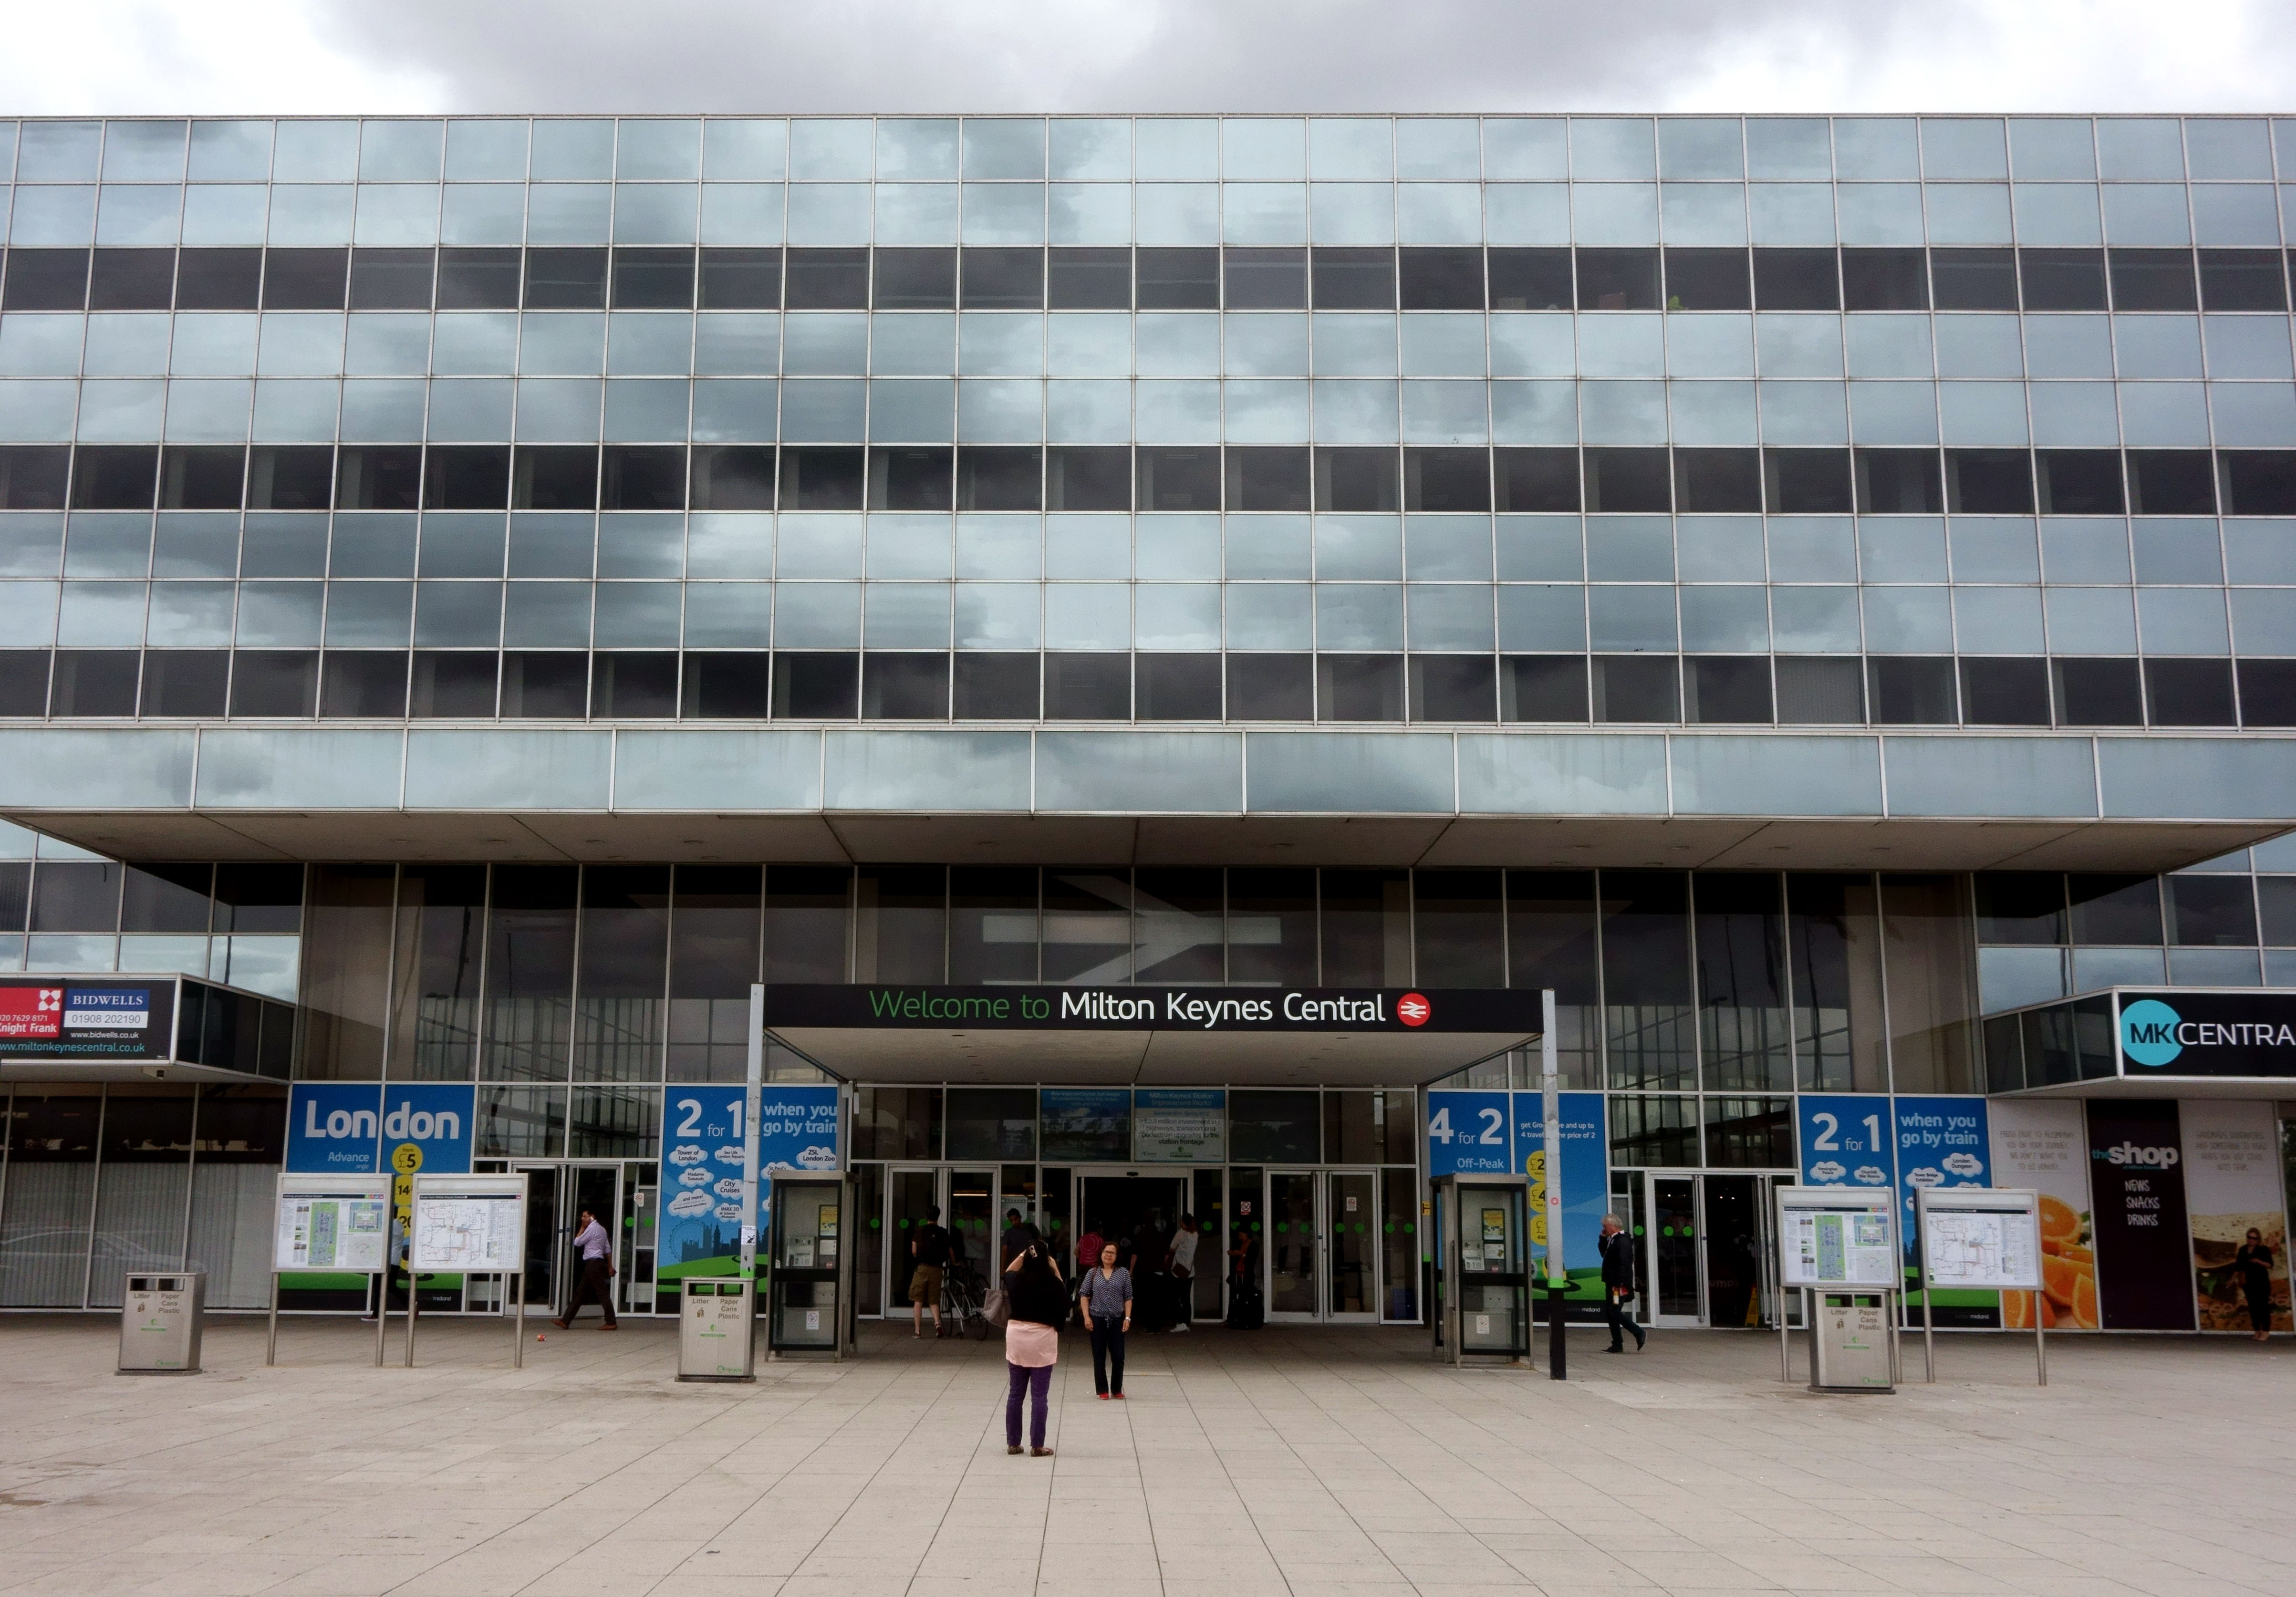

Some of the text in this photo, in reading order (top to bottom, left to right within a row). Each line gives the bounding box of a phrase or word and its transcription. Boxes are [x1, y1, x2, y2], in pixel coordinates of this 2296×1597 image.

[73, 996, 143, 1005] BIDWELLS
[870, 990, 1386, 1028] Welcome to Milton Keynes Central
[72, 1015, 141, 1024] 01908 202190
[30, 1024, 57, 1033] Frank
[676, 1099, 742, 1138] 2 for 1
[764, 1102, 837, 1120] when you
[305, 1100, 460, 1140] London
[763, 1120, 837, 1137] go by train
[1429, 1108, 1503, 1144] 4 for 2
[1900, 1113, 1976, 1130] when you
[1812, 1113, 1880, 1151] 2 for 1
[1901, 1130, 1978, 1148] go by train
[328, 1151, 369, 1162] Advance
[398, 1153, 416, 1168] £5
[1457, 1158, 1504, 1168] Off-Peak
[2092, 1149, 2111, 1159] the
[2108, 1141, 2178, 1169] shop
[2124, 1179, 2150, 1192] NEWS
[2126, 1196, 2160, 1209] SNACKS
[2127, 1214, 2158, 1226] DRINKS
